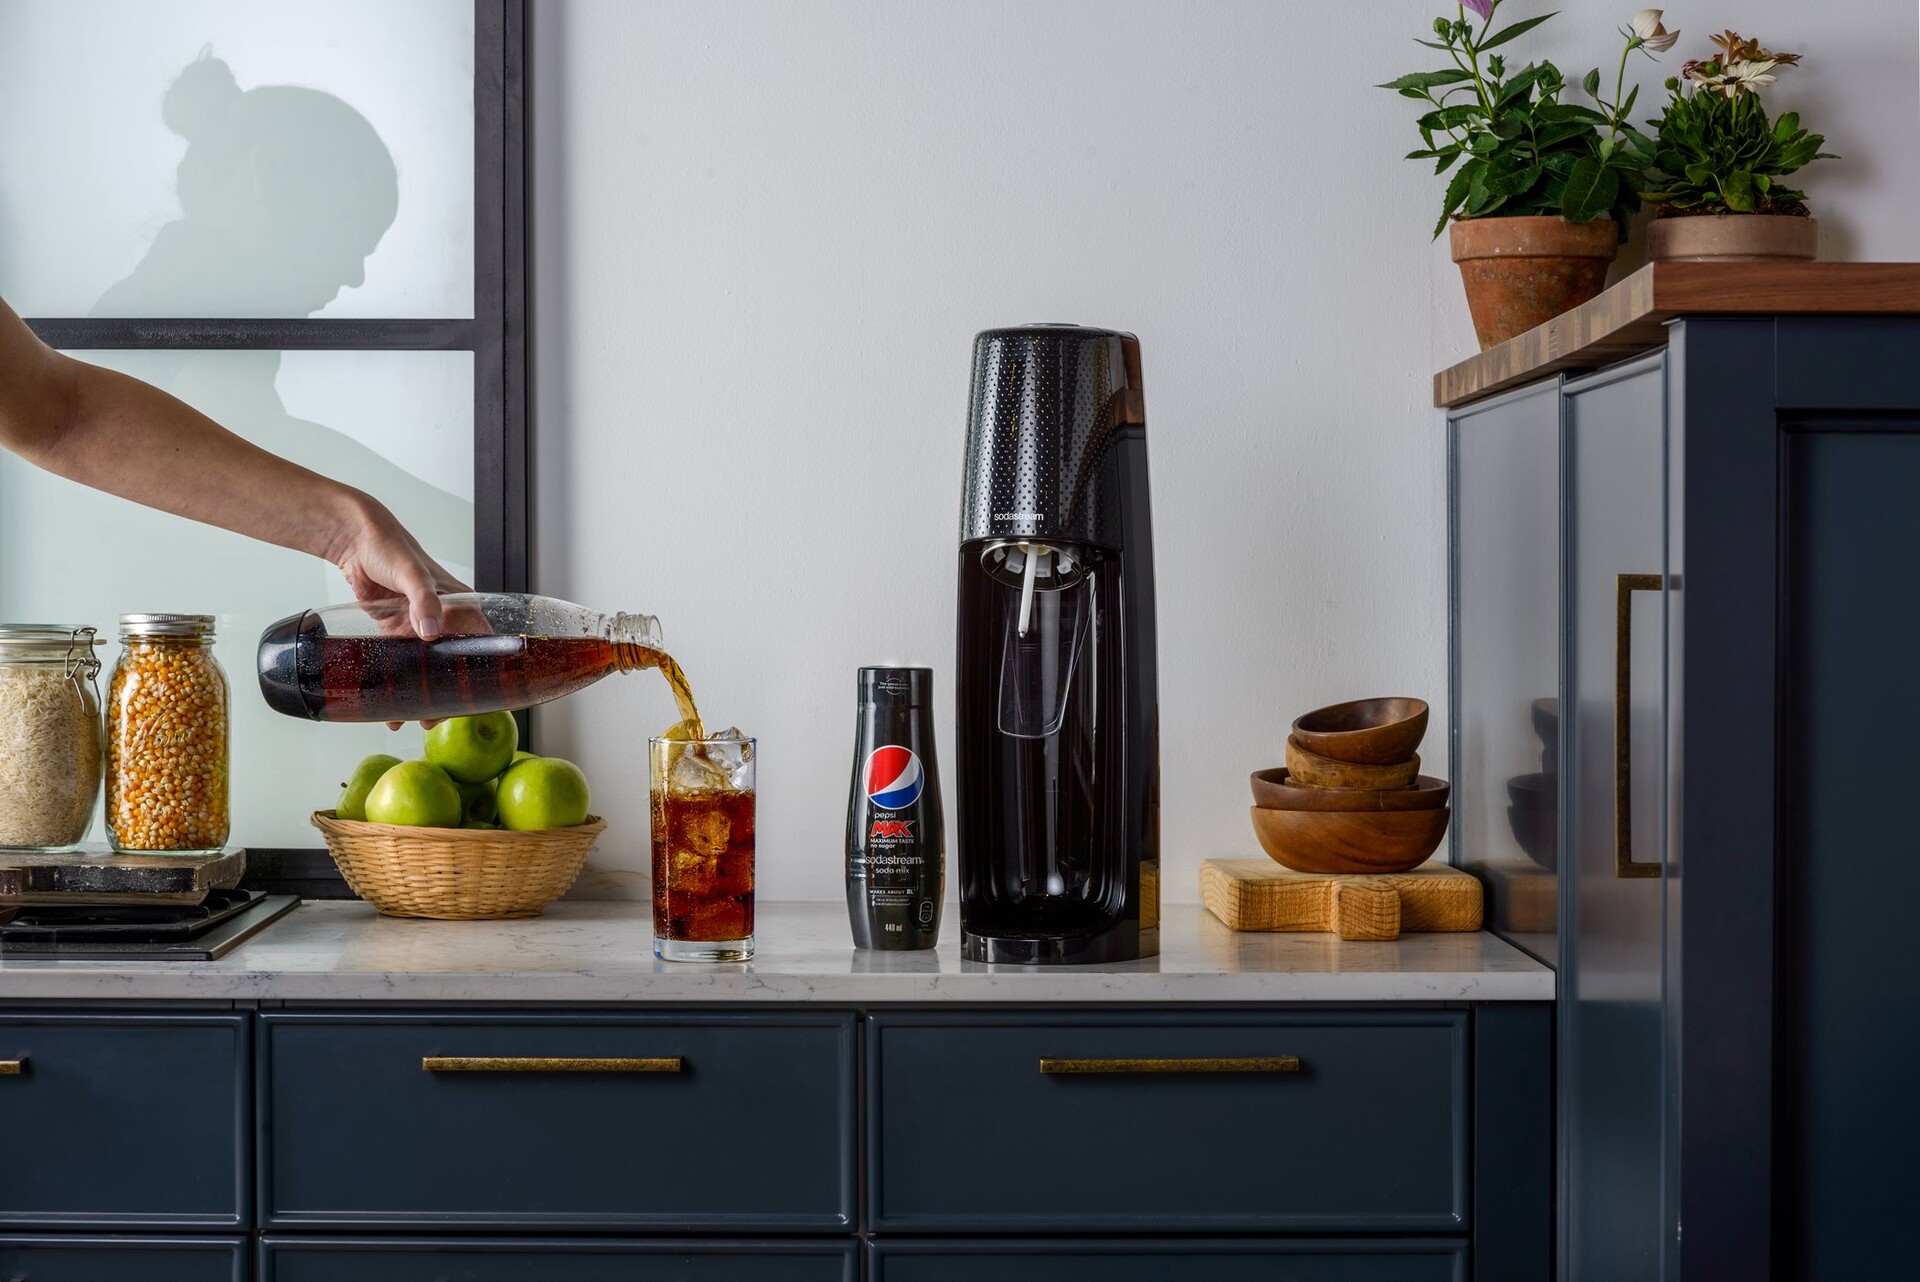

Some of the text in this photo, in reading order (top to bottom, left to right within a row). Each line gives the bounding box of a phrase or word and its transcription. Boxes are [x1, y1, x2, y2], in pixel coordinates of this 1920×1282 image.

[994, 511, 1044, 521] sodastream
[874, 812, 897, 820] pepsi
[870, 820, 916, 838] MAX
[865, 855, 922, 865] sodastream
[884, 923, 896, 932] 440
